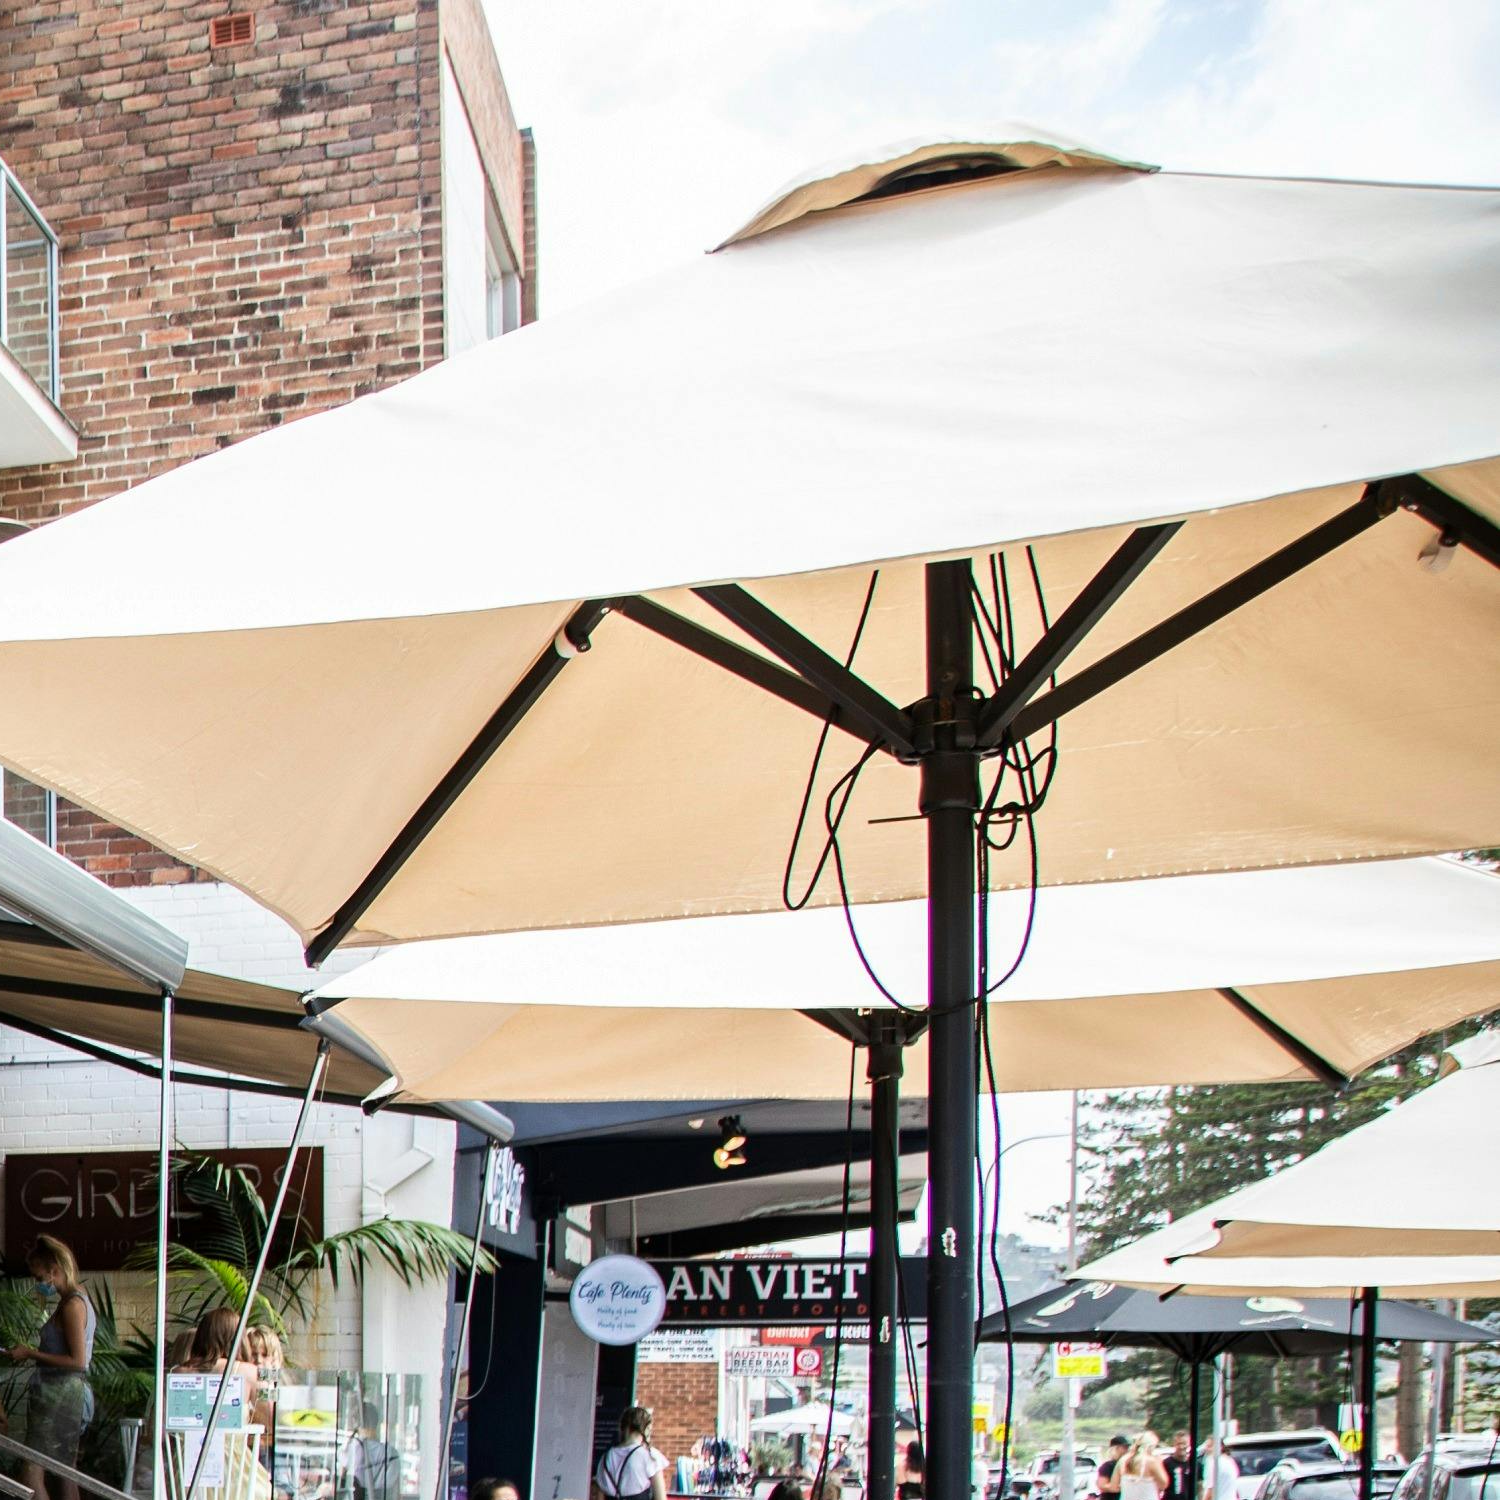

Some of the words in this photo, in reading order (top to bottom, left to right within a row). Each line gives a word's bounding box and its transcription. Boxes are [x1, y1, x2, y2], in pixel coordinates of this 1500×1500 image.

[666, 1264, 734, 1300] AN
[746, 1262, 867, 1300] VIET
[578, 1281, 604, 1304] Cafe
[610, 1281, 658, 1305] Plenty
[733, 1351, 790, 1359] AUSTRIAN
[733, 1359, 762, 1367] BEER
[766, 1359, 790, 1367] BAR
